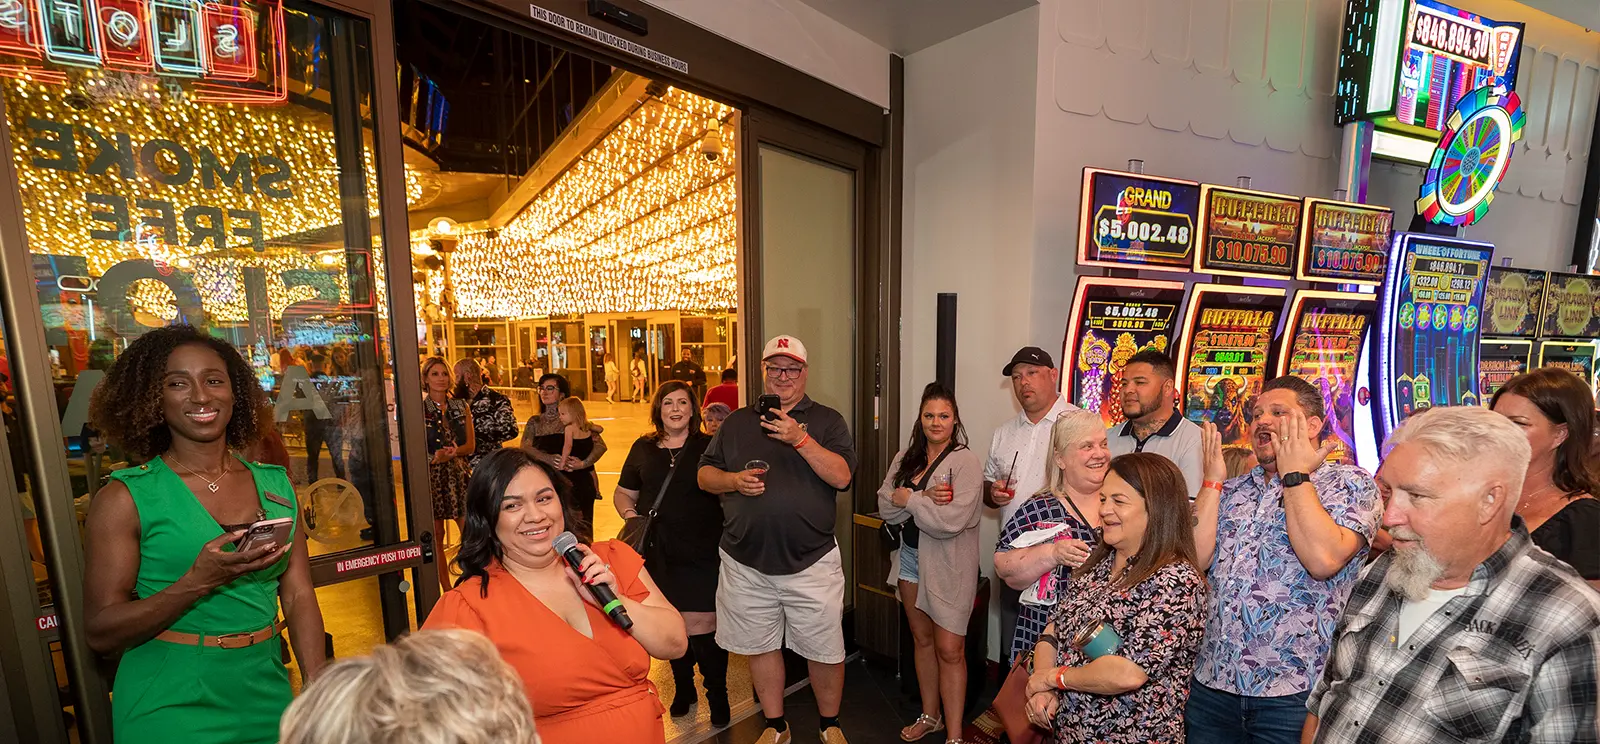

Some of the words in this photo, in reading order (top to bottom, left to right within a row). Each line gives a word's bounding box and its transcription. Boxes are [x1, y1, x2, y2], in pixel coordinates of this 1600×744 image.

[532, 6, 547, 20] THIS
[548, 12, 566, 28] DOOR
[566, 18, 575, 31] TO
[576, 22, 597, 40] REMAIN
[599, 30, 628, 51] UNLOCKED
[628, 41, 647, 58] DURING
[647, 48, 671, 67] BUSINESS
[671, 57, 687, 72] HOURS
[1415, 14, 1490, 60] $846,894.30
[1124, 185, 1172, 210] GRAND
[1214, 196, 1298, 224] BUFFALO
[1317, 208, 1391, 234] BUFFALO
[1099, 217, 1189, 245] $5,002.48
[1257, 235, 1277, 243] JACKPOT
[1415, 243, 1440, 256] WHEEL
[1450, 247, 1481, 260] FORTUNE
[1487, 286, 1530, 301] DRAGON
[1104, 305, 1159, 318] $5,002.48
[1200, 308, 1275, 327] BUFFALO
[1499, 304, 1521, 319] LINK
[1301, 313, 1366, 330] BUFFALO
[777, 338, 789, 349] N
[336, 561, 345, 573] IN
[345, 553, 380, 571] EMERGENCY
[381, 551, 397, 563] PUSH
[397, 549, 405, 560] TO
[405, 545, 421, 558] OPEN
[1464, 619, 1497, 635] JACK
